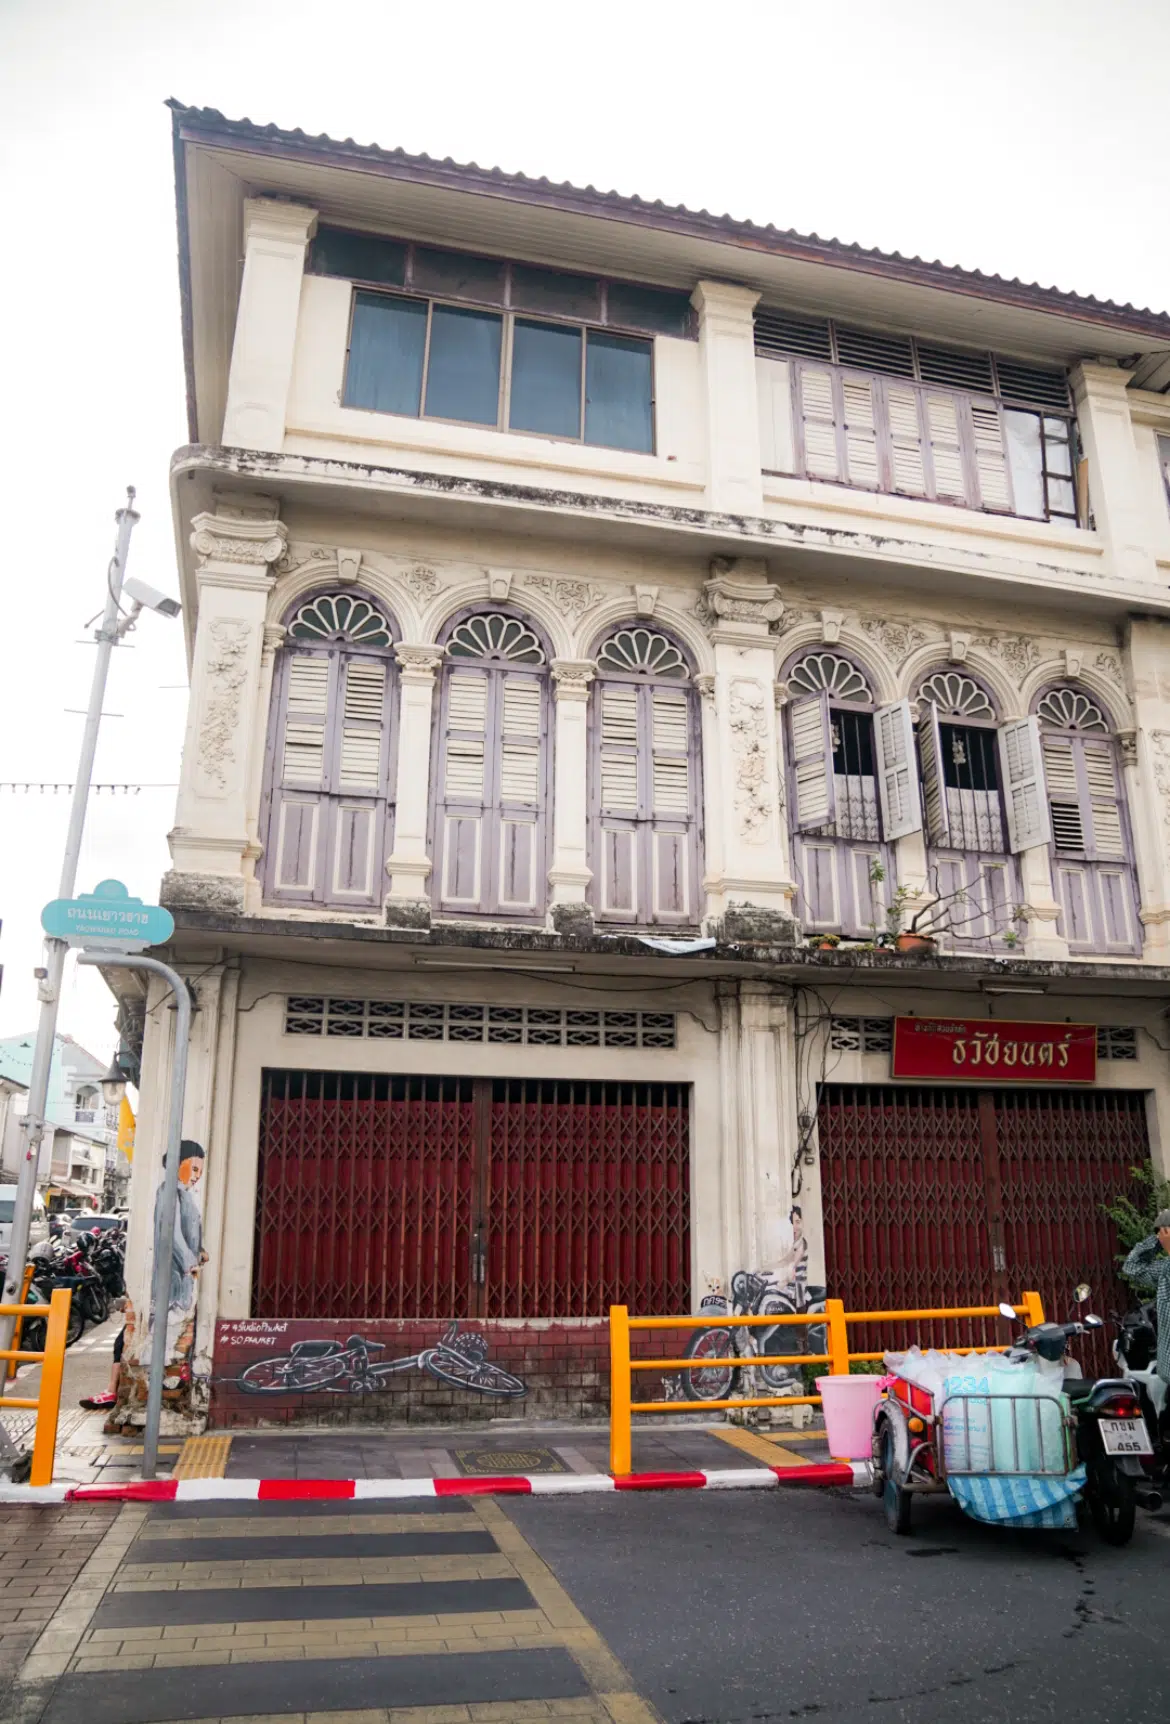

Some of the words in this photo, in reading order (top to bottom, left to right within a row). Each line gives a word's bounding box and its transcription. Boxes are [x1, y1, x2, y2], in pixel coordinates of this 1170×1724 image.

[67, 907, 149, 925] ถนนเยาวราช
[118, 926, 140, 937] ROAD
[942, 1375, 990, 1397] 1234
[1117, 1442, 1142, 1452] 455
